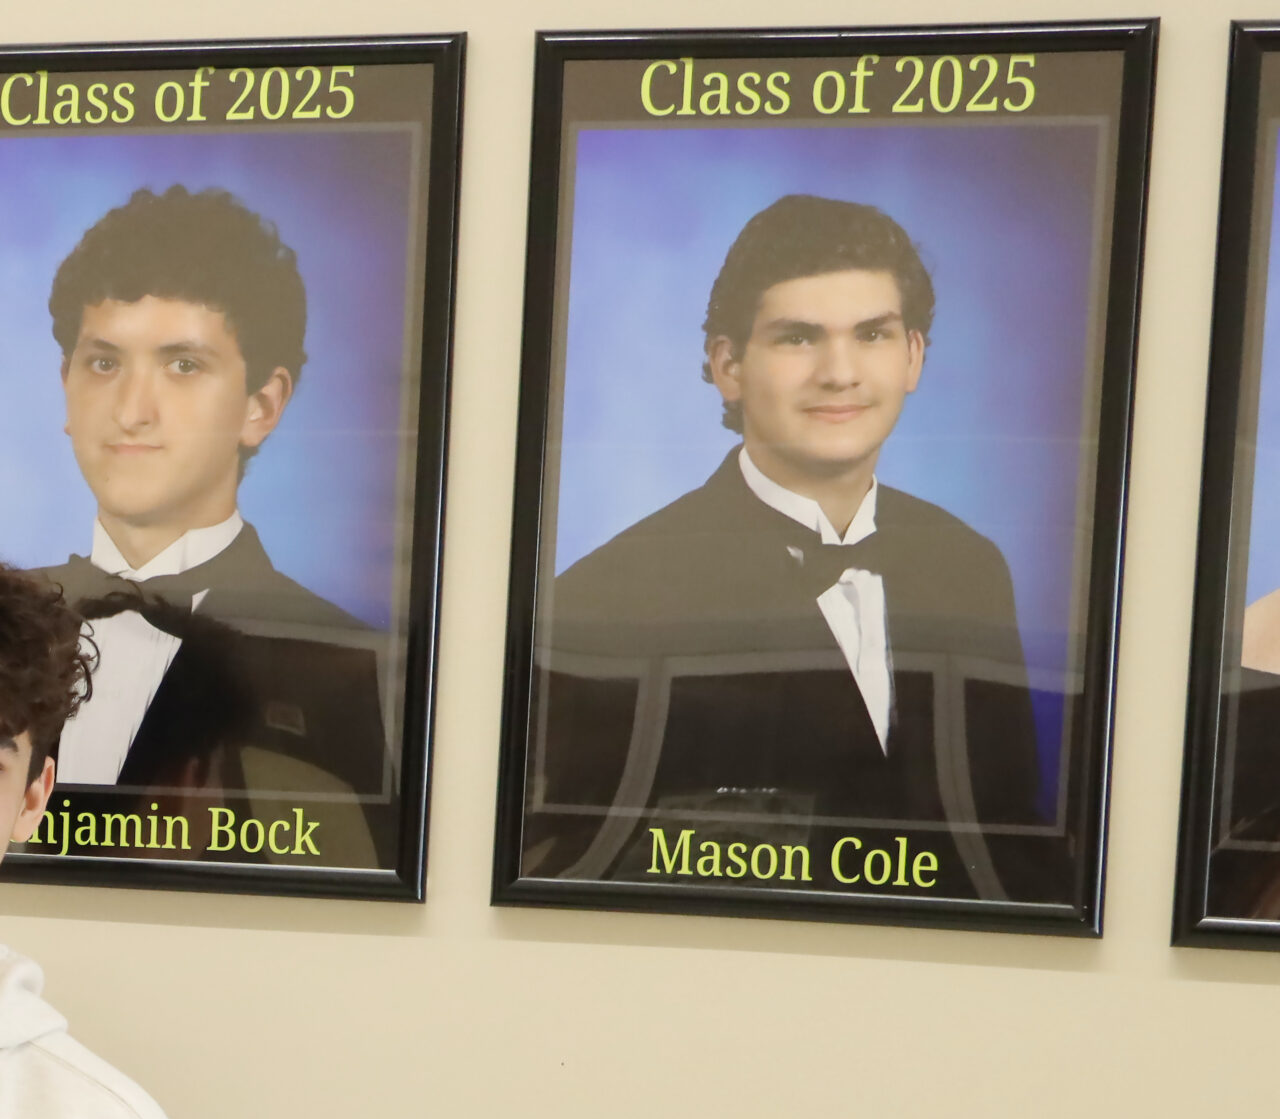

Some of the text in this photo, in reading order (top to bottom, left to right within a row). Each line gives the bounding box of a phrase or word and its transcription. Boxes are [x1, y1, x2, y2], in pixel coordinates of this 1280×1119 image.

[0, 65, 357, 127] Class of 2025
[640, 53, 1037, 117] Class of 2025
[8, 799, 321, 857] njamin Bock
[646, 827, 939, 889] Mason Cole
